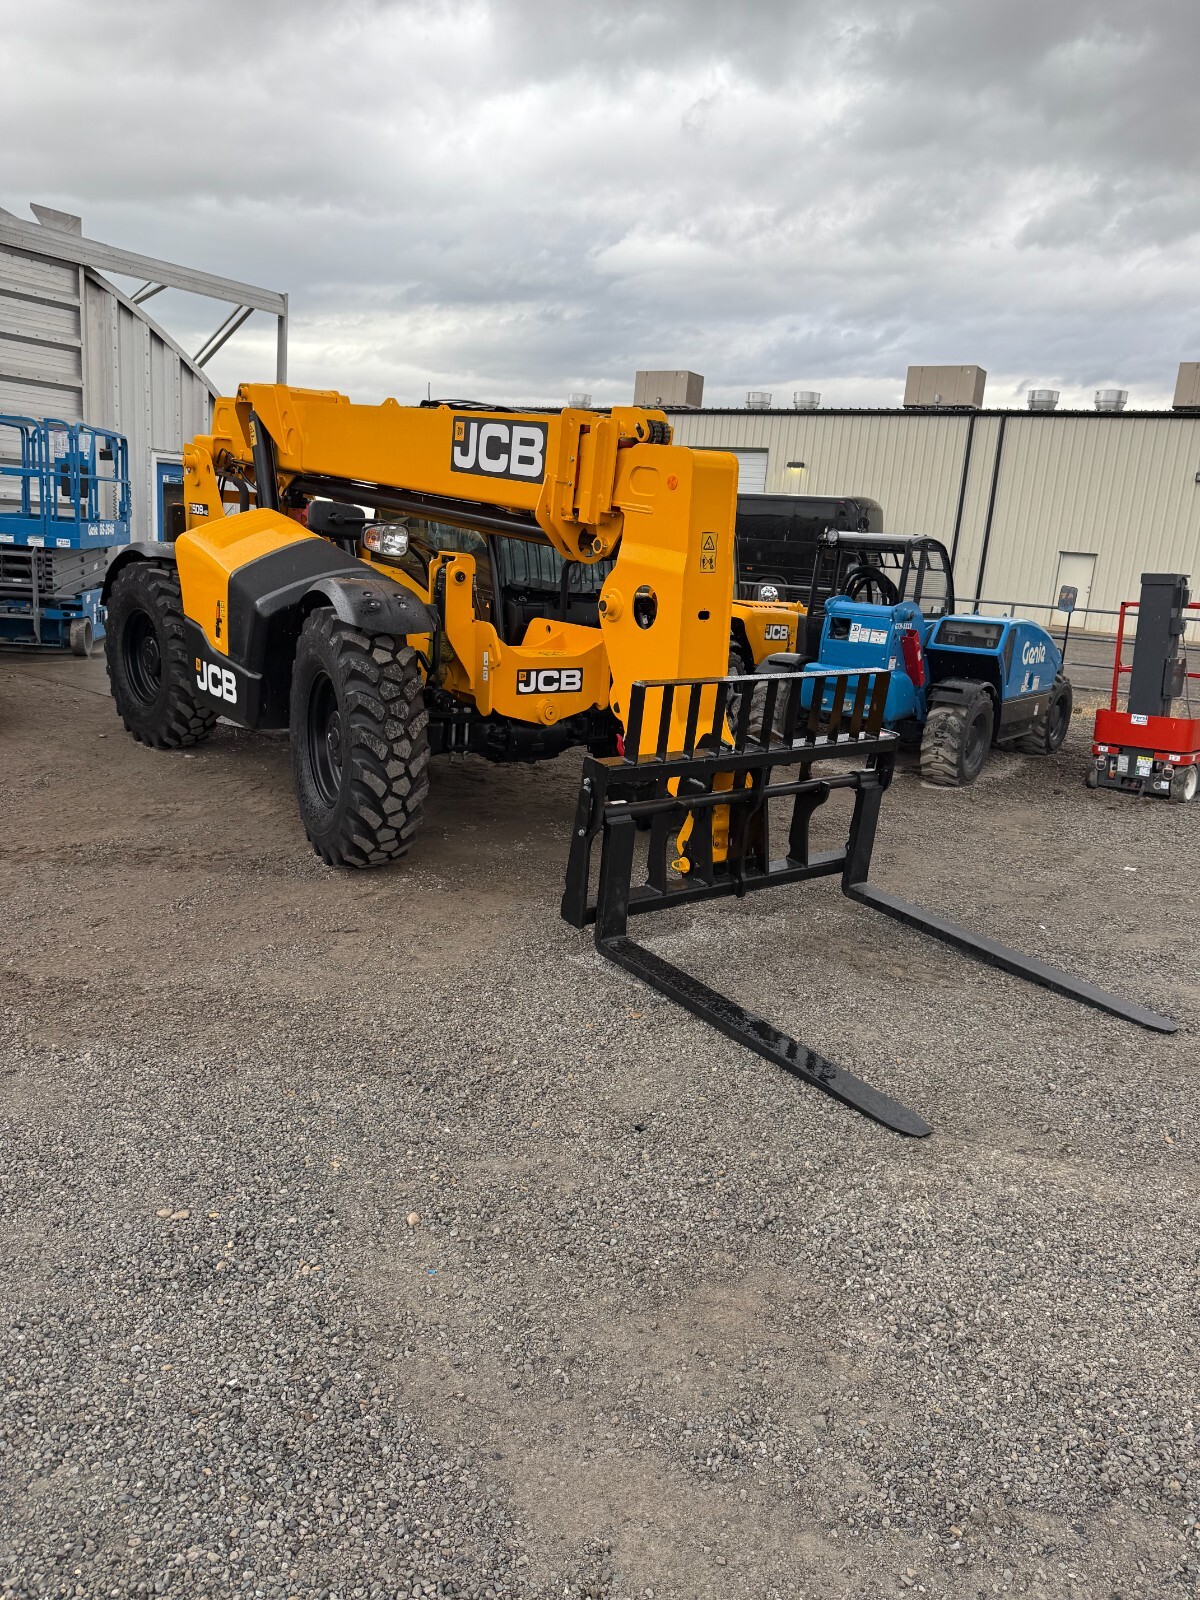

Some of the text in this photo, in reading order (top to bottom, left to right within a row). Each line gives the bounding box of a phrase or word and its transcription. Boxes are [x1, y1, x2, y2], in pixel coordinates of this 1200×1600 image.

[453, 422, 544, 478] JCB
[765, 624, 789, 640] JCB
[1022, 640, 1046, 666] Genie
[196, 660, 237, 705] JCB
[517, 669, 582, 693] JCB
